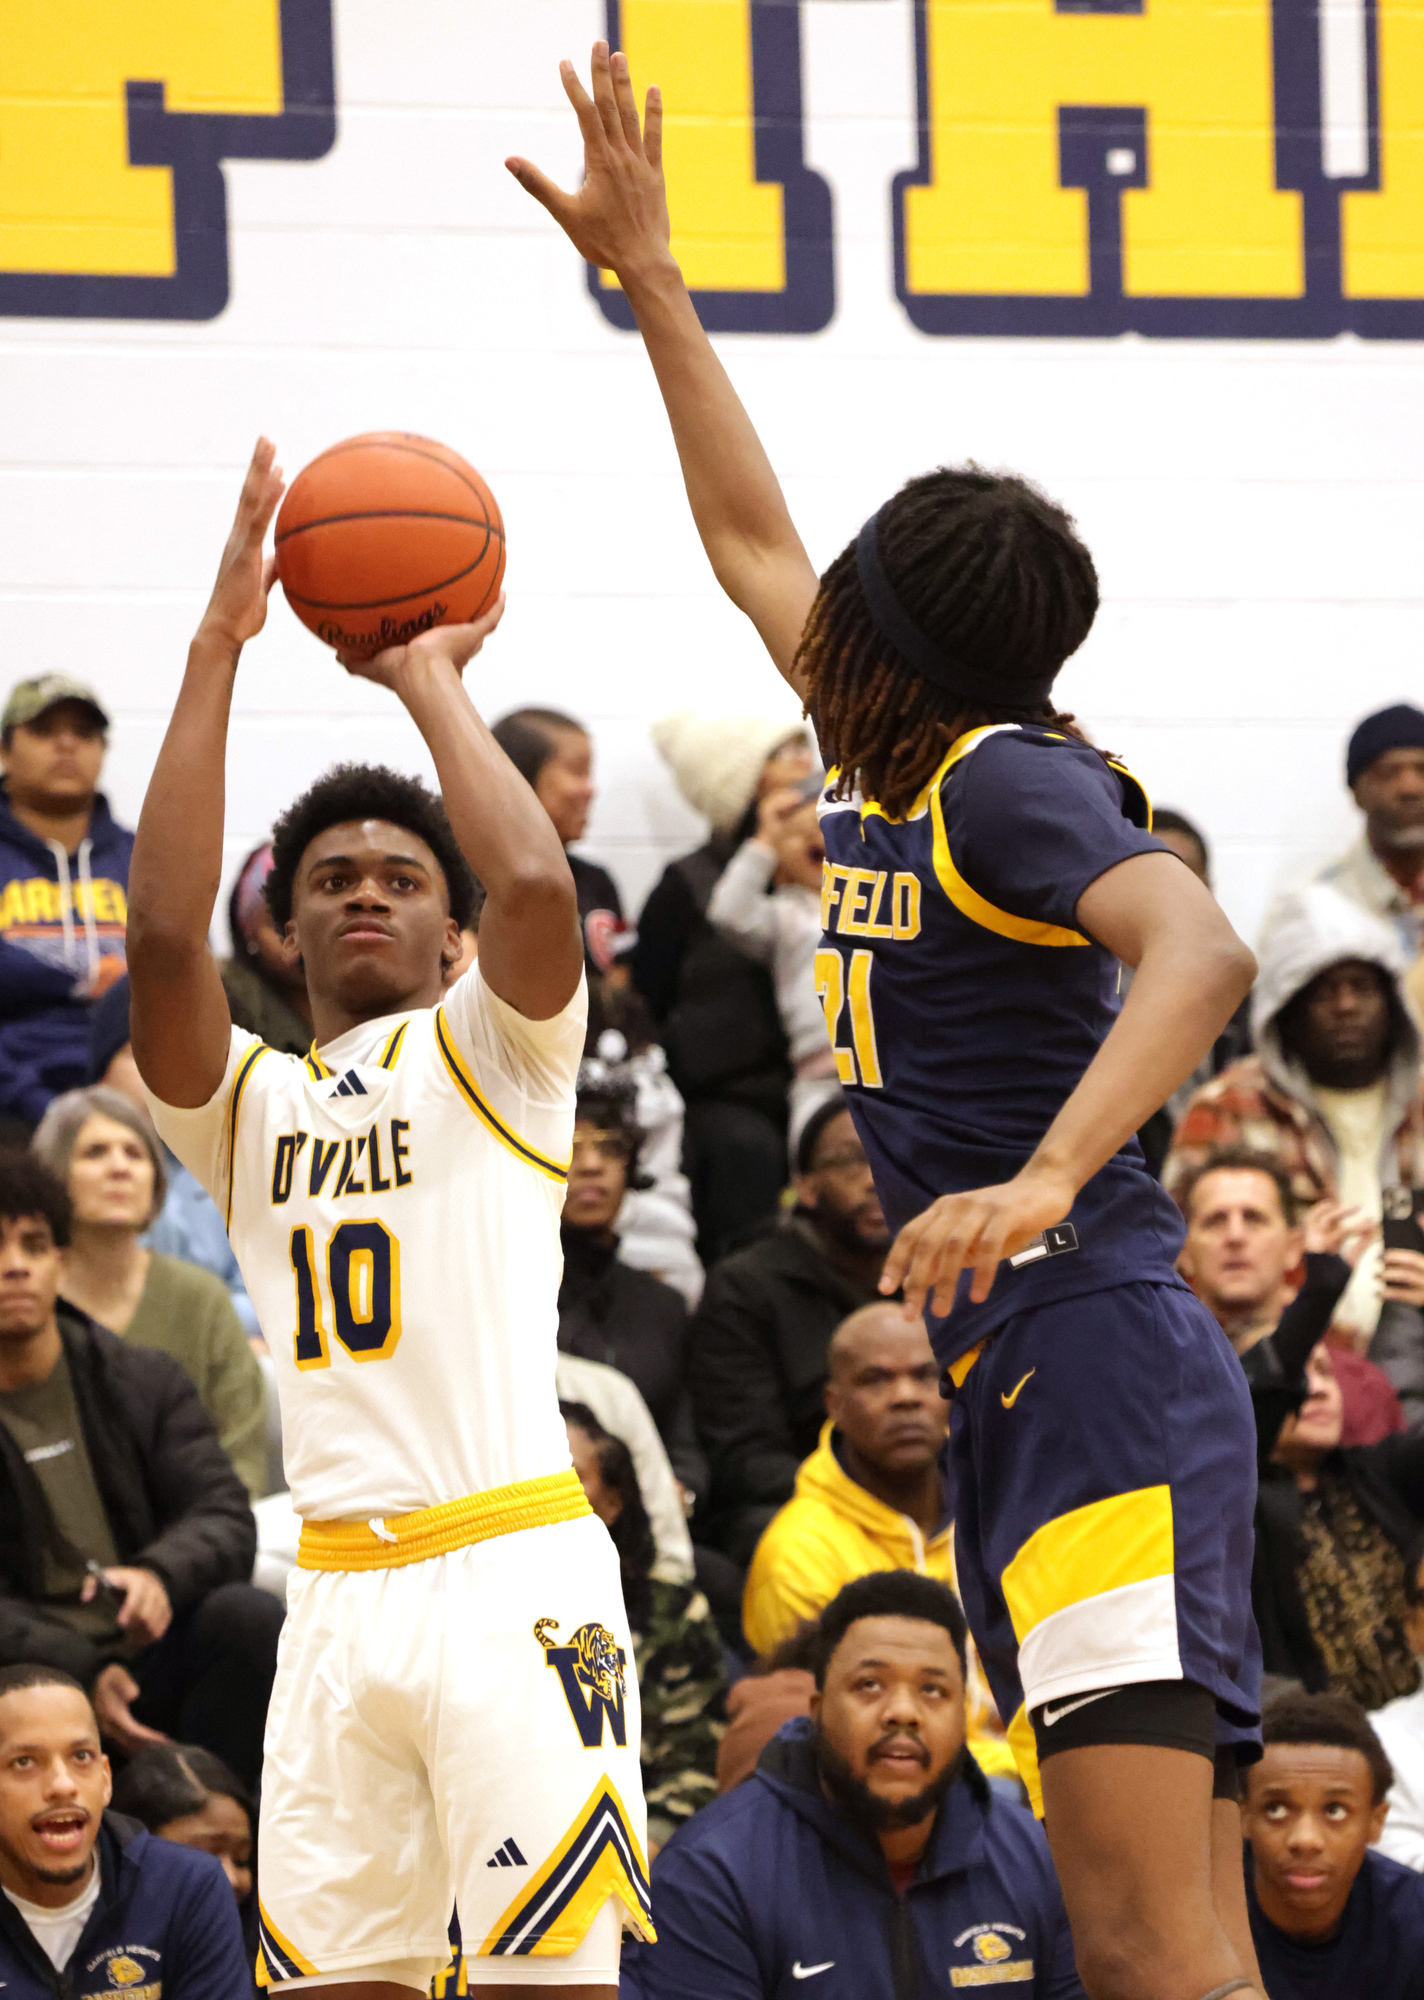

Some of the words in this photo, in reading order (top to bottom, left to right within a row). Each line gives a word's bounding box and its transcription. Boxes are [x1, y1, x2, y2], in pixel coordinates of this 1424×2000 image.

[814, 948, 884, 1089] 21
[289, 1217, 402, 1371] 10
[1055, 1232, 1066, 1245] L
[544, 1645, 627, 1749] W
